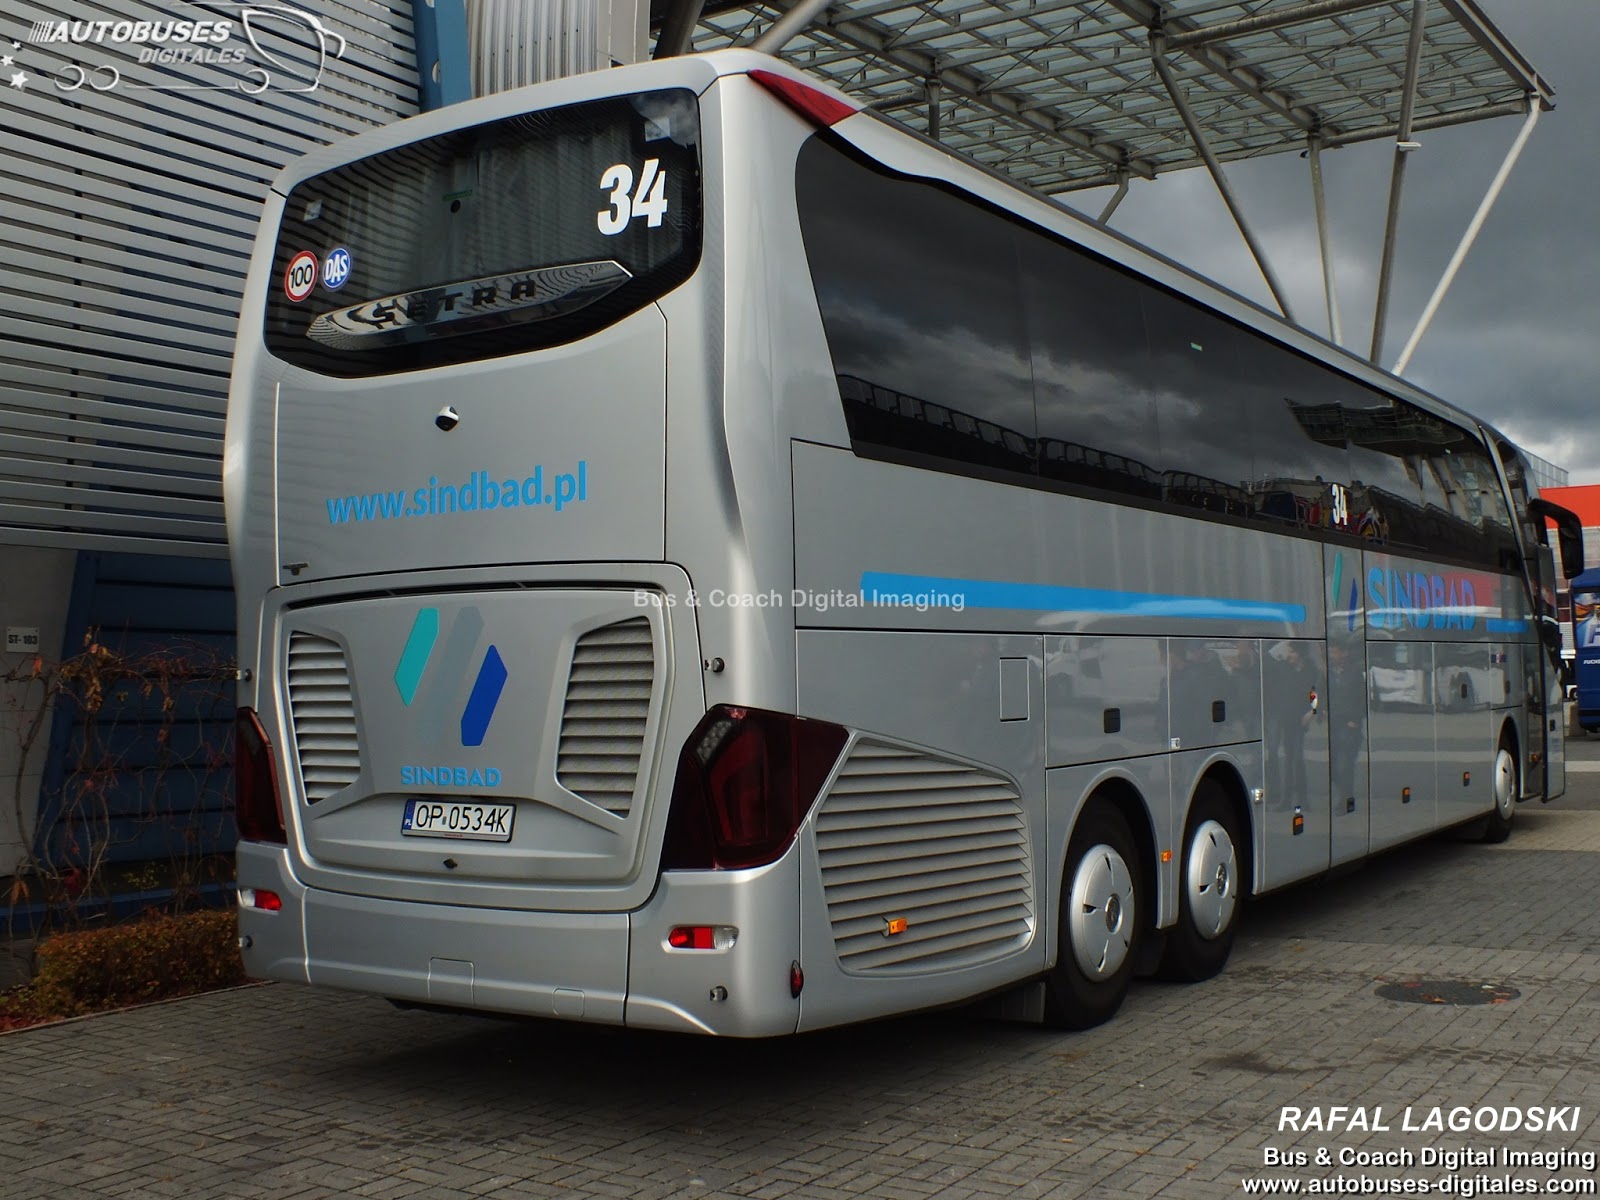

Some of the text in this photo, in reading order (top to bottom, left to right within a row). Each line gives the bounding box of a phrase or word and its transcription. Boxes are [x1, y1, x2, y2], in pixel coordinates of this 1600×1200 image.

[597, 158, 667, 236] 34
[291, 264, 313, 289] 100
[325, 254, 348, 283] DAS
[372, 279, 537, 325] SETRA
[326, 460, 587, 525] www.sindbad.pl
[1331, 484, 1348, 526] 34
[1368, 567, 1476, 630] SINDBAD
[400, 766, 502, 787] SINDBAD
[404, 818, 412, 826] PL
